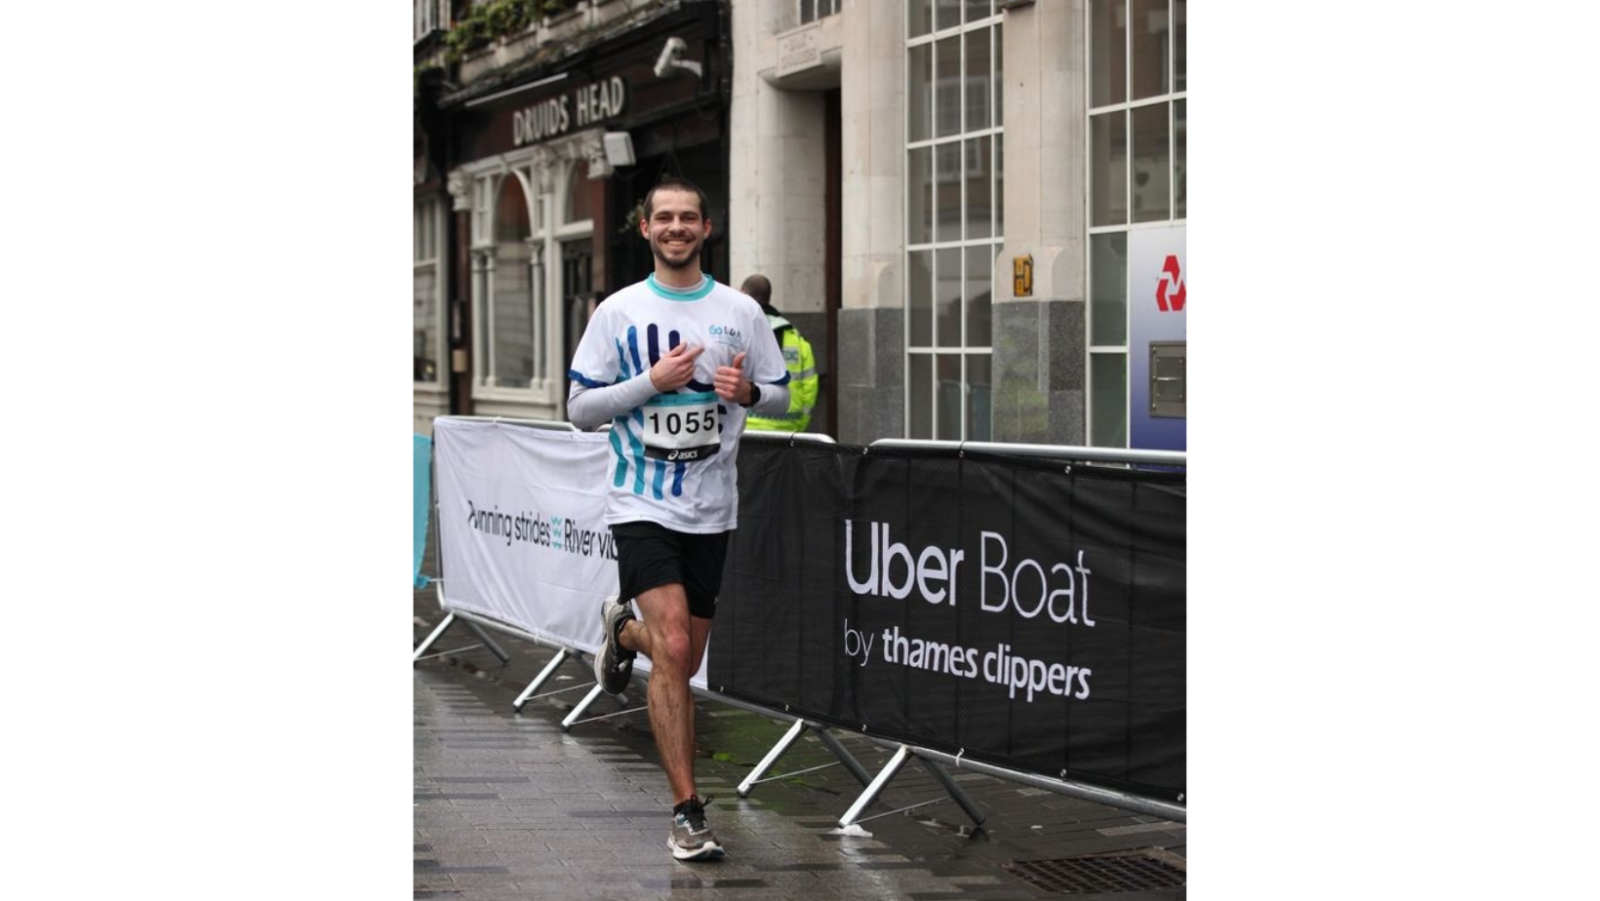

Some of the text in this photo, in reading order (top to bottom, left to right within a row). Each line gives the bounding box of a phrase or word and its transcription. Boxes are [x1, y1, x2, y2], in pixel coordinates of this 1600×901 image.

[513, 76, 625, 147] DRUIDS HEAD
[649, 409, 715, 436] 1055
[678, 450, 699, 460] asics
[514, 511, 550, 547] strides
[564, 518, 595, 556] River
[845, 519, 1096, 627] Uber Boat
[844, 618, 1092, 702] by thames clippers
